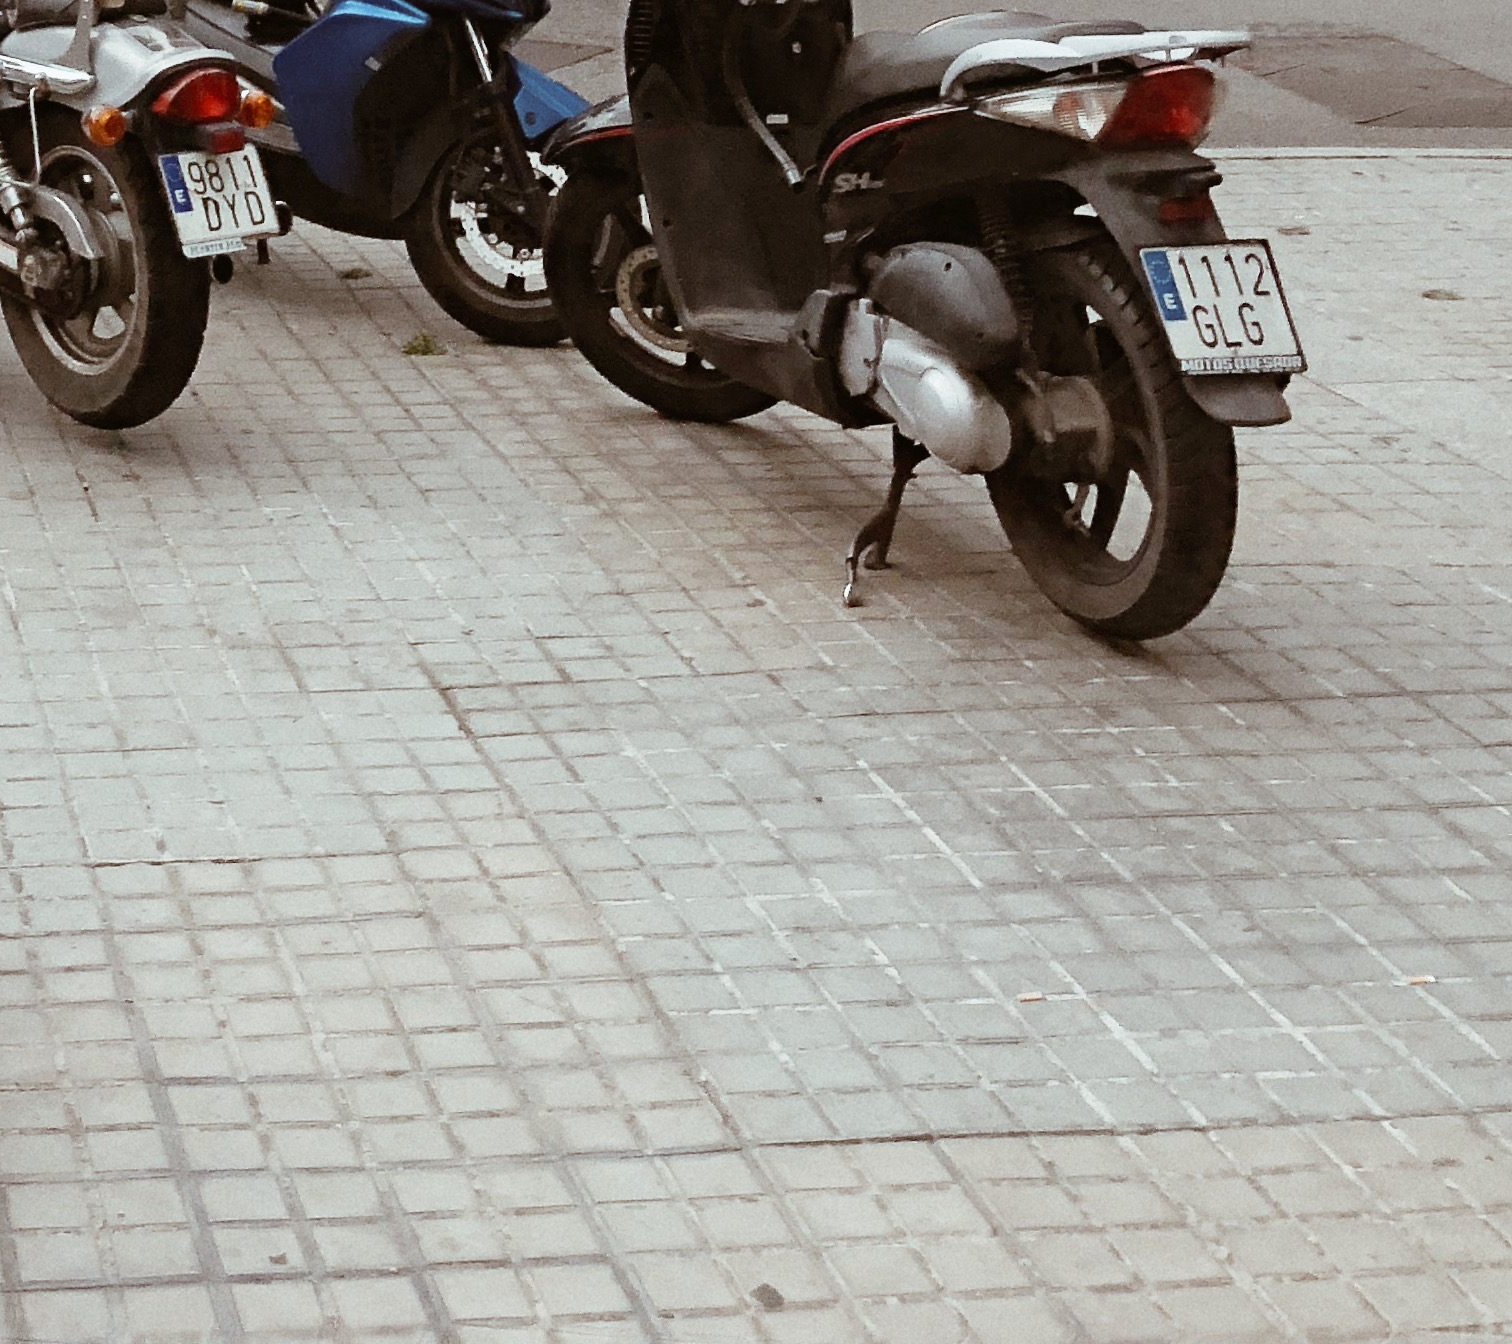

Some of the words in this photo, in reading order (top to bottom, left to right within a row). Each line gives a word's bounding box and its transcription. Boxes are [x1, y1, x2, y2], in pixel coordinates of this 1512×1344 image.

[188, 155, 257, 194] 9811
[174, 188, 186, 204] E
[201, 190, 265, 232] DYD
[1178, 252, 1271, 299] 1112
[1162, 292, 1178, 310] E
[1192, 302, 1265, 348] GLG
[1180, 358, 1233, 372] MOTOS
